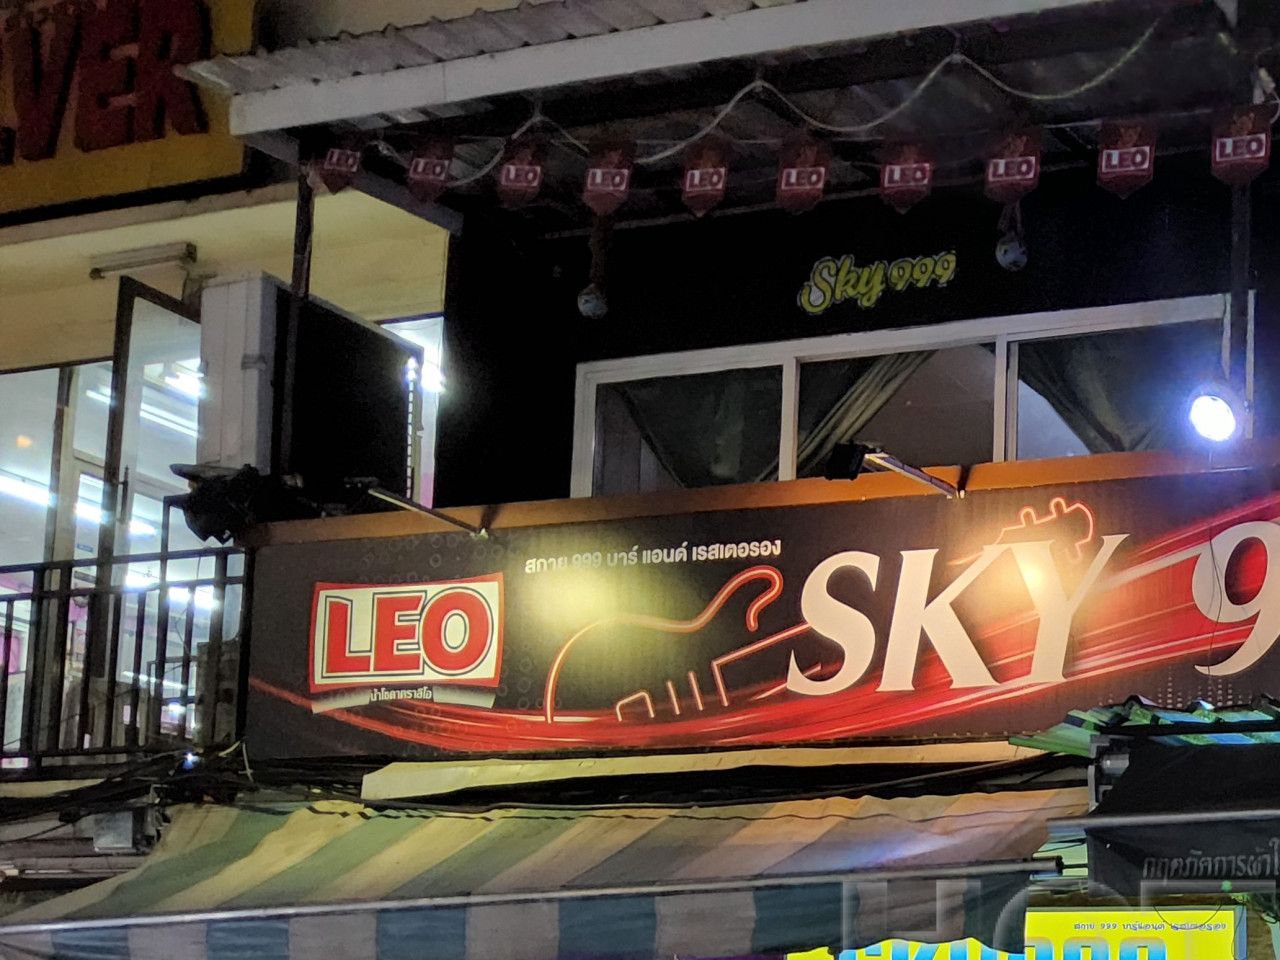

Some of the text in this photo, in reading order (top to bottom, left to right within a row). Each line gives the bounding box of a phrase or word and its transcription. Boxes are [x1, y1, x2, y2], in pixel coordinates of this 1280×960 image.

[0, 0, 208, 166] VER
[1219, 137, 1263, 158] LEO
[992, 158, 1033, 180] LEO
[1106, 149, 1147, 171] LEO
[504, 167, 538, 184] LEO
[591, 170, 625, 190] LEO
[690, 170, 723, 190] LEO
[784, 169, 823, 188] LEO
[888, 165, 927, 186] LEO
[800, 251, 957, 313] Sky 999
[572, 551, 602, 569] 999
[607, 545, 638, 567] บาร์
[642, 541, 688, 564] แอนด์
[692, 539, 782, 561] เรสเตอรอง
[787, 530, 1131, 696] SKY
[321, 586, 493, 678] LEO
